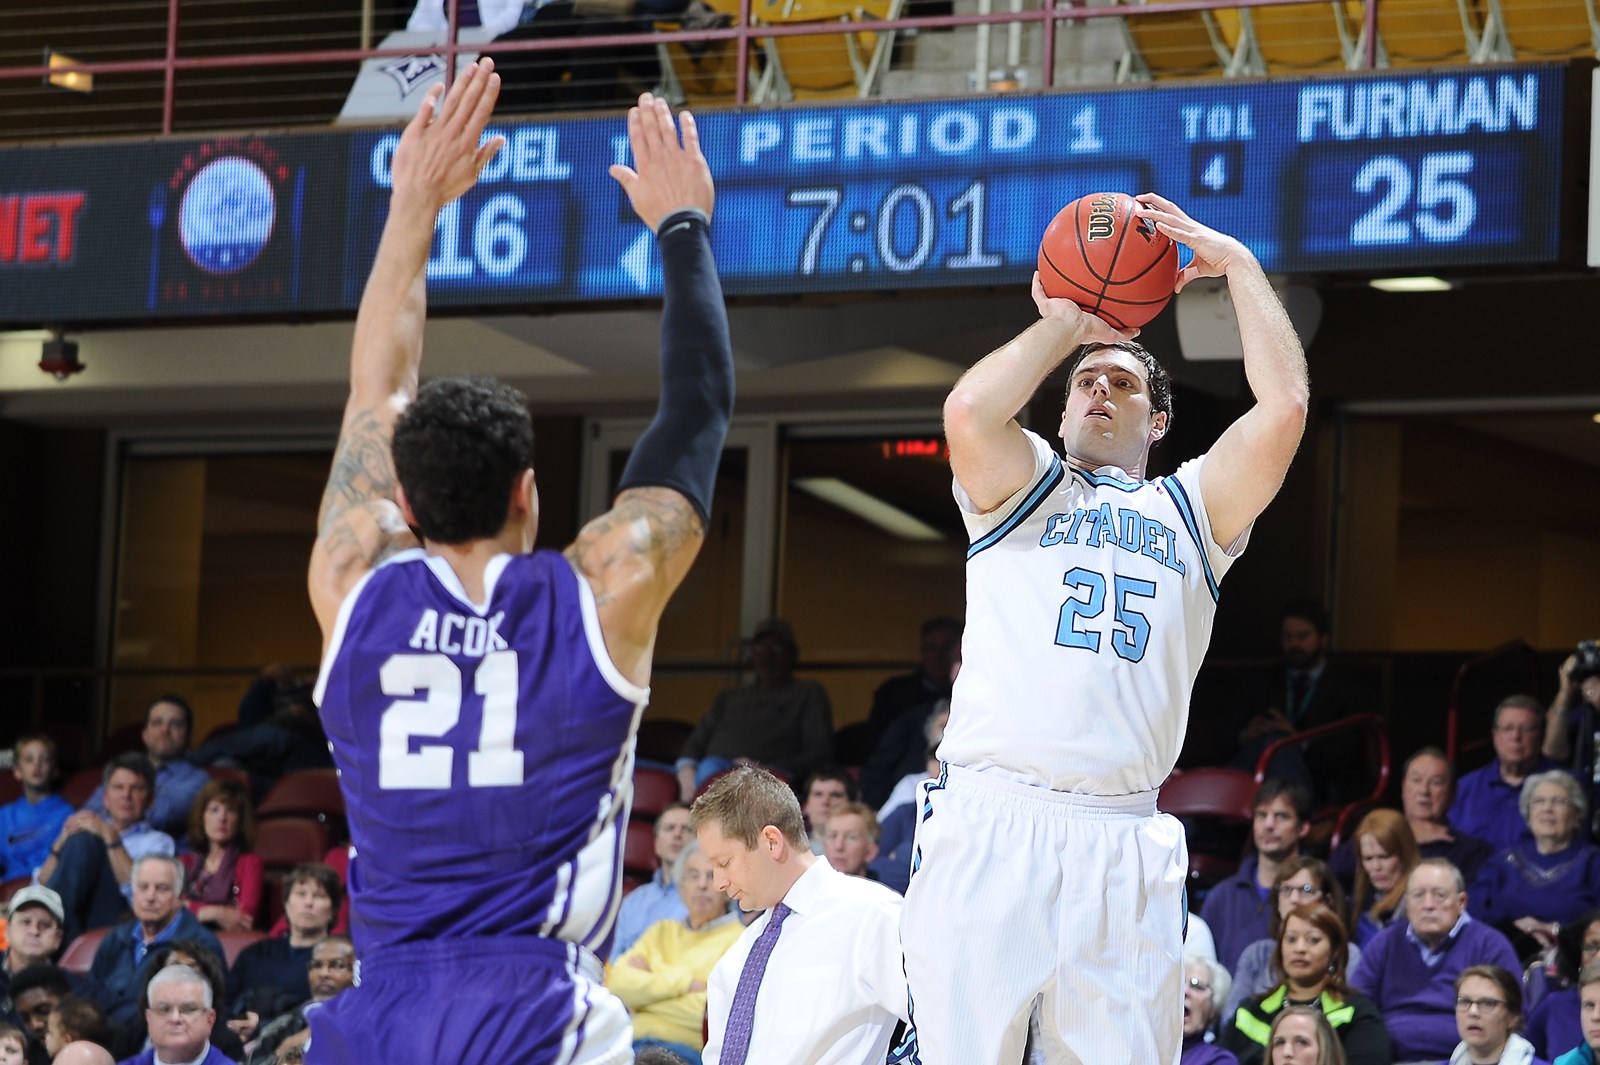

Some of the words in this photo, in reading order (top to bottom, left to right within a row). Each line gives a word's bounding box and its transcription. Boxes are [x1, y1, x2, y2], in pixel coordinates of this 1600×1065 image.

[740, 106, 1038, 165] PERIOD
[1070, 104, 1103, 153] 1
[1298, 74, 1539, 142] FURMAN
[1201, 153, 1225, 190] 4
[1349, 151, 1478, 246] 25
[426, 192, 529, 280] 16
[788, 180, 1003, 275] 7:01
[1040, 502, 1186, 580] CITADEL
[1054, 566, 1157, 664] 25
[379, 649, 525, 790] 21
